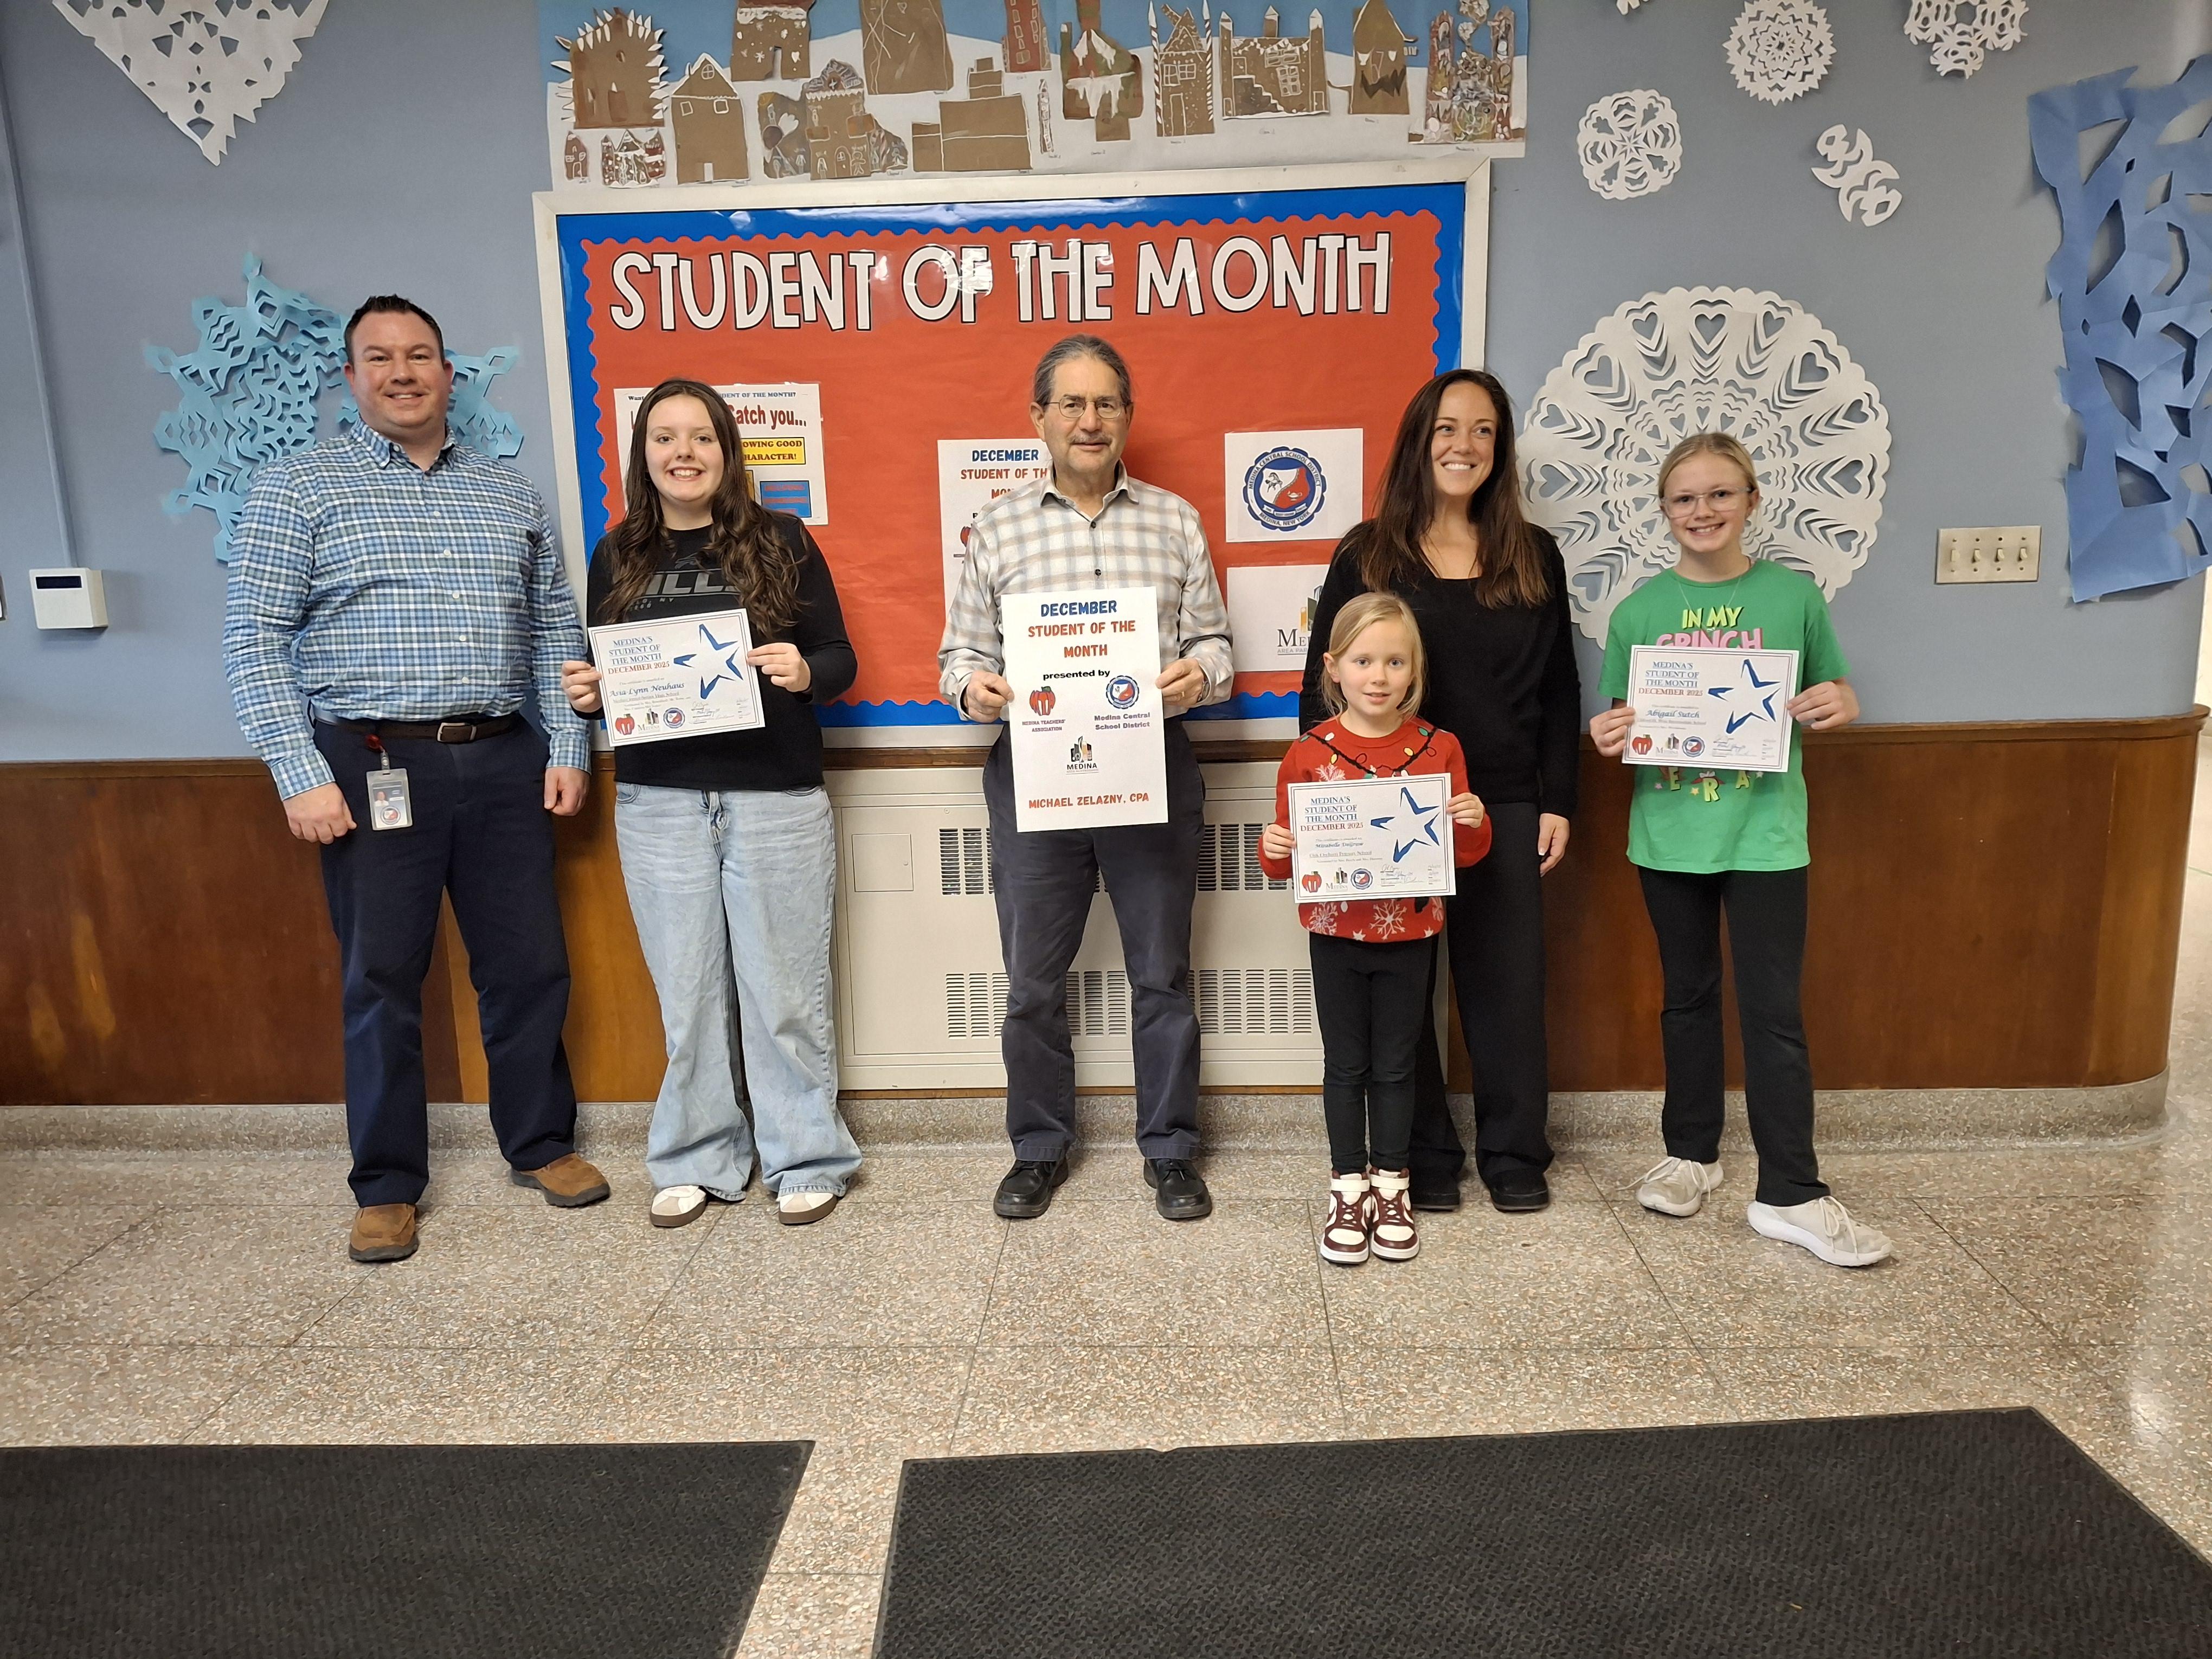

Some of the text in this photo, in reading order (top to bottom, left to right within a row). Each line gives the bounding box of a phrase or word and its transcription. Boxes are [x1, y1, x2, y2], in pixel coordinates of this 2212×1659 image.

[610, 232, 1391, 331] STUDENT OF THE MONTH
[770, 409, 807, 430] you...
[972, 449, 1039, 462] DECEMBER
[960, 467, 1048, 480] STUDENT OF TH
[1249, 451, 1321, 489] MEDINA CENTRAL SCHOOL DISTRICT
[1296, 510, 1311, 523] YORK
[645, 573, 738, 595] ILL
[1040, 600, 1117, 617] DECEMBER
[1682, 605, 1745, 629] IN MY
[1028, 620, 1136, 638] STUDENT OF THE
[613, 635, 653, 646] MEDINA'S
[609, 645, 647, 656] STUDENT
[1064, 644, 1108, 658] MONTH
[612, 653, 661, 665] THE MONTH
[1652, 661, 1693, 669] MEDINA'S
[608, 661, 670, 674] DECEMBER 2025
[1043, 669, 1111, 681] presented by
[651, 682, 685, 692] Neuhaus
[1665, 679, 1697, 687] MONTH
[1638, 687, 1684, 696] DECEMBER
[1066, 762, 1098, 770] MEDINA
[1028, 792, 1149, 808] MICHAEL ZELAZNY, CPA
[1310, 796, 1351, 805] MEDINA'S
[1304, 806, 1344, 814] STUDENT
[1325, 813, 1357, 821] MONTH
[1300, 823, 1346, 832] DECEMBER
